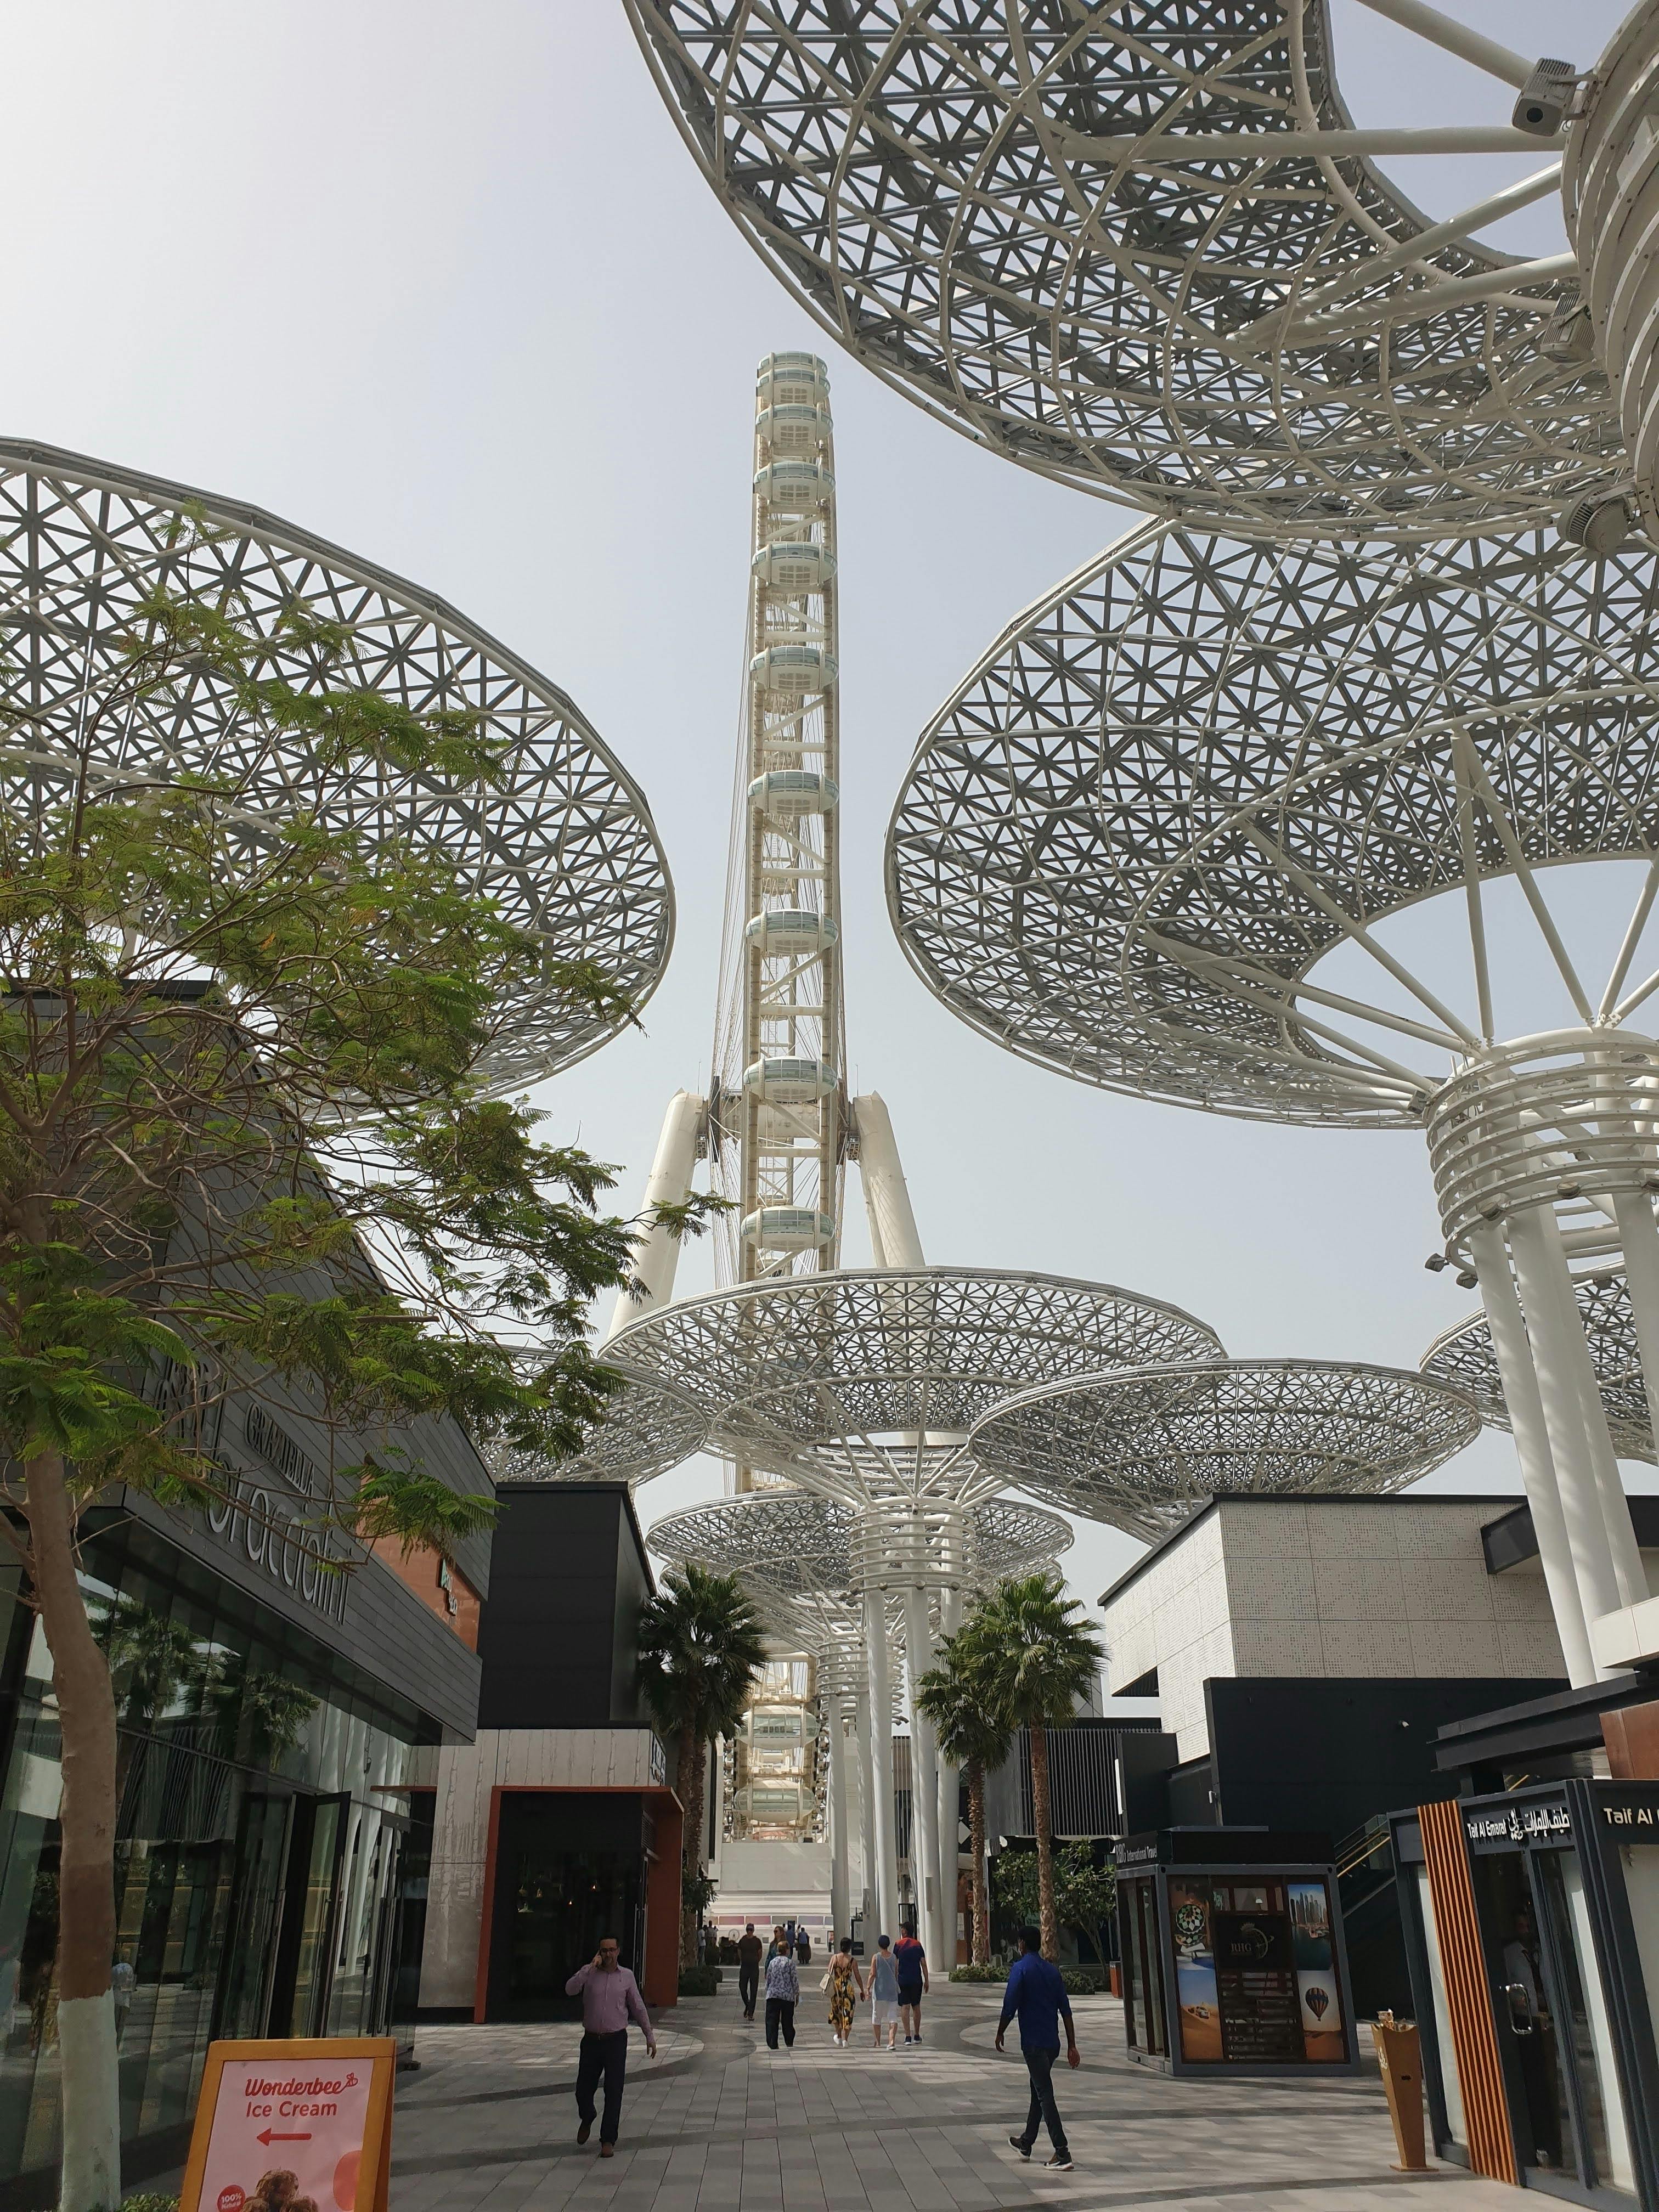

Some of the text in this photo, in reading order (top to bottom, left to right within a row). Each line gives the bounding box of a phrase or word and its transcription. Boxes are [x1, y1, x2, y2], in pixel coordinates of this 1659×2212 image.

[1603, 1808, 1633, 1824] Taif
[1637, 1808, 1653, 1825] Al
[1115, 1843, 1126, 1864] RHG
[1230, 1943, 1252, 1953] RHG
[245, 2078, 344, 2096] Wonderbee
[246, 2101, 337, 2118] Ice Cream
[221, 2193, 242, 2203] 100%
